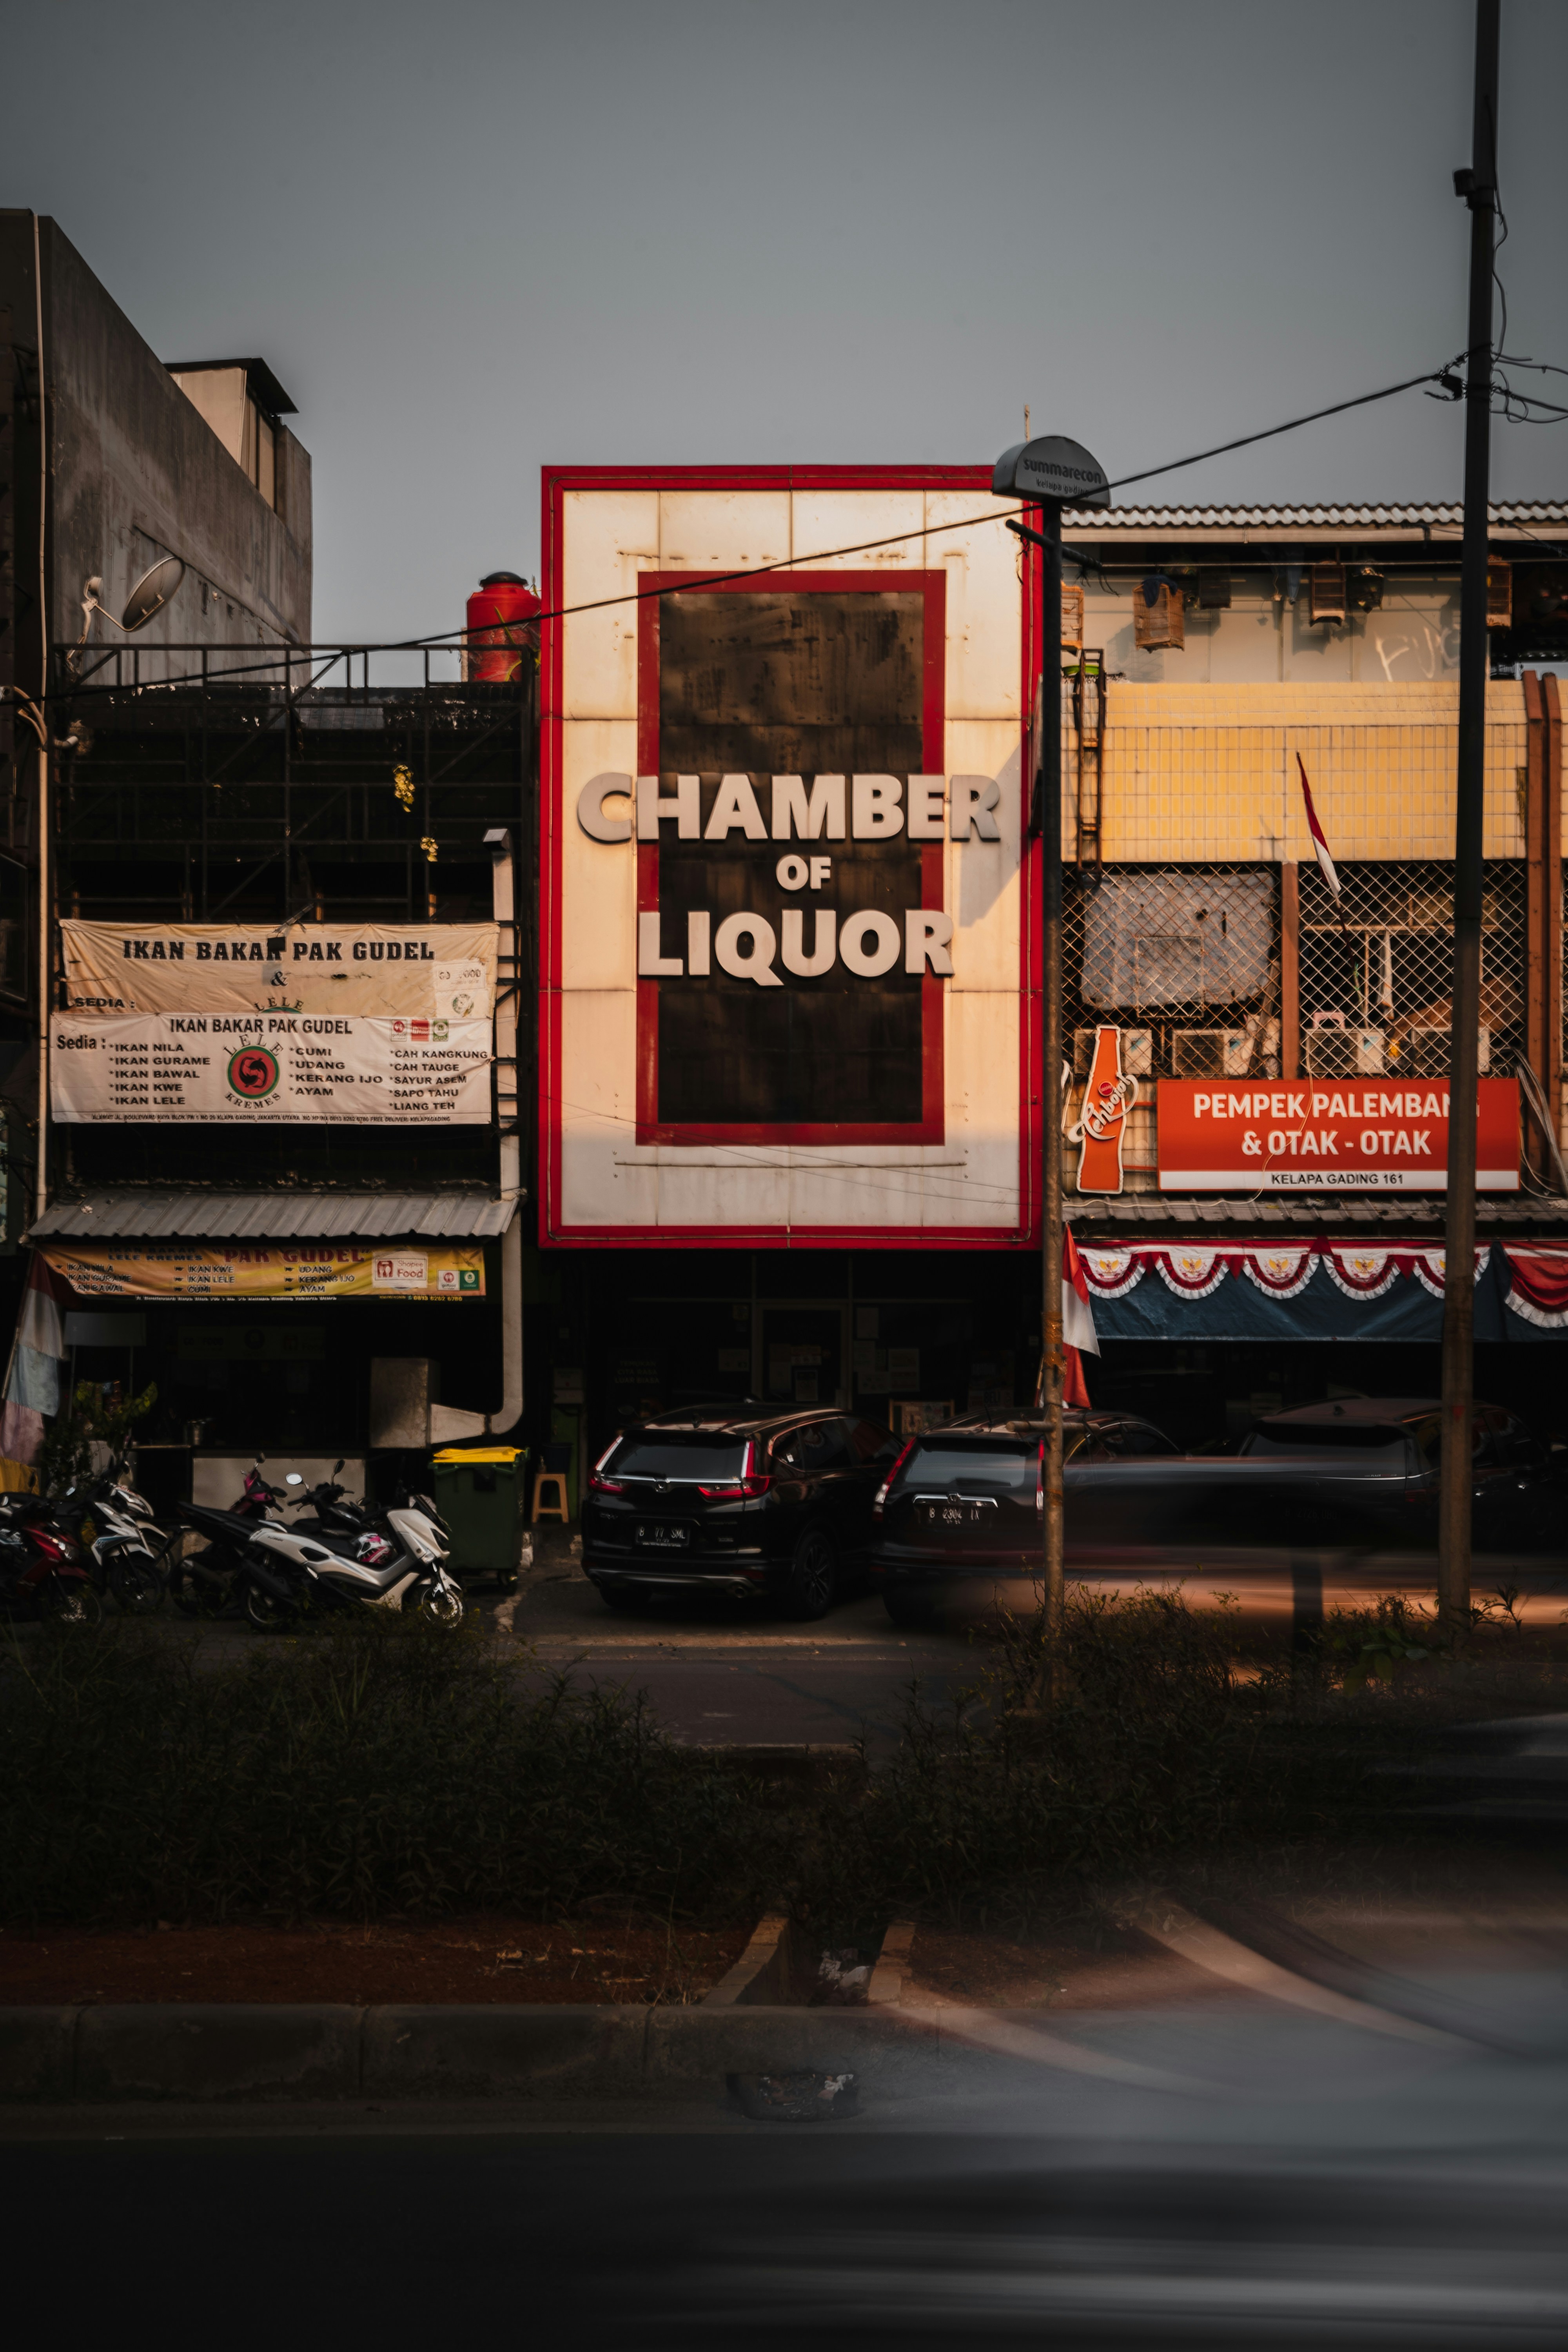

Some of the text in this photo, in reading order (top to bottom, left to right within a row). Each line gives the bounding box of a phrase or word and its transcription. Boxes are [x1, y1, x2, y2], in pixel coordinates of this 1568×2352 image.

[1023, 458, 1102, 484] summarecon
[1036, 477, 1090, 495] kelapa gadin
[577, 772, 1001, 843] CHAMBER
[776, 853, 831, 891] OF
[123, 940, 184, 960] IKAN
[293, 942, 342, 961] PAK
[353, 942, 435, 961] GUDEL
[639, 909, 955, 986] LIQUOR
[271, 971, 288, 987] &
[75, 997, 125, 1008] SEDIA
[255, 997, 303, 1012] LELE
[171, 1019, 353, 1035] IKAN BAKAR PAK GUDEL
[57, 1034, 97, 1050] Sedia
[223, 1034, 283, 1057] LELE
[296, 1048, 332, 1056] CUMI
[422, 1051, 488, 1059] KANGKUNG
[296, 1062, 346, 1070] UDANG
[296, 1074, 355, 1083] KERANG
[394, 1076, 467, 1085] SAYUR ASEM
[296, 1088, 334, 1096] AYAM
[394, 1089, 459, 1097] SAPO TAHU
[225, 1092, 281, 1109] KREMES
[1194, 1092, 1480, 1118] PEMPEK PALEMBA
[394, 1102, 455, 1111] LIANG TEH
[1241, 1131, 1262, 1156] &
[1267, 1131, 1339, 1156] OTAK
[1360, 1131, 1432, 1156] OTAK
[1271, 1174, 1404, 1185] KELAPA GADING 161
[67, 1263, 114, 1272] IKAN NILA
[187, 1265, 235, 1273] IKAN KWE
[397, 1269, 423, 1278] Food
[91, 1284, 125, 1292] BAWAL
[639, 1525, 645, 1536] B
